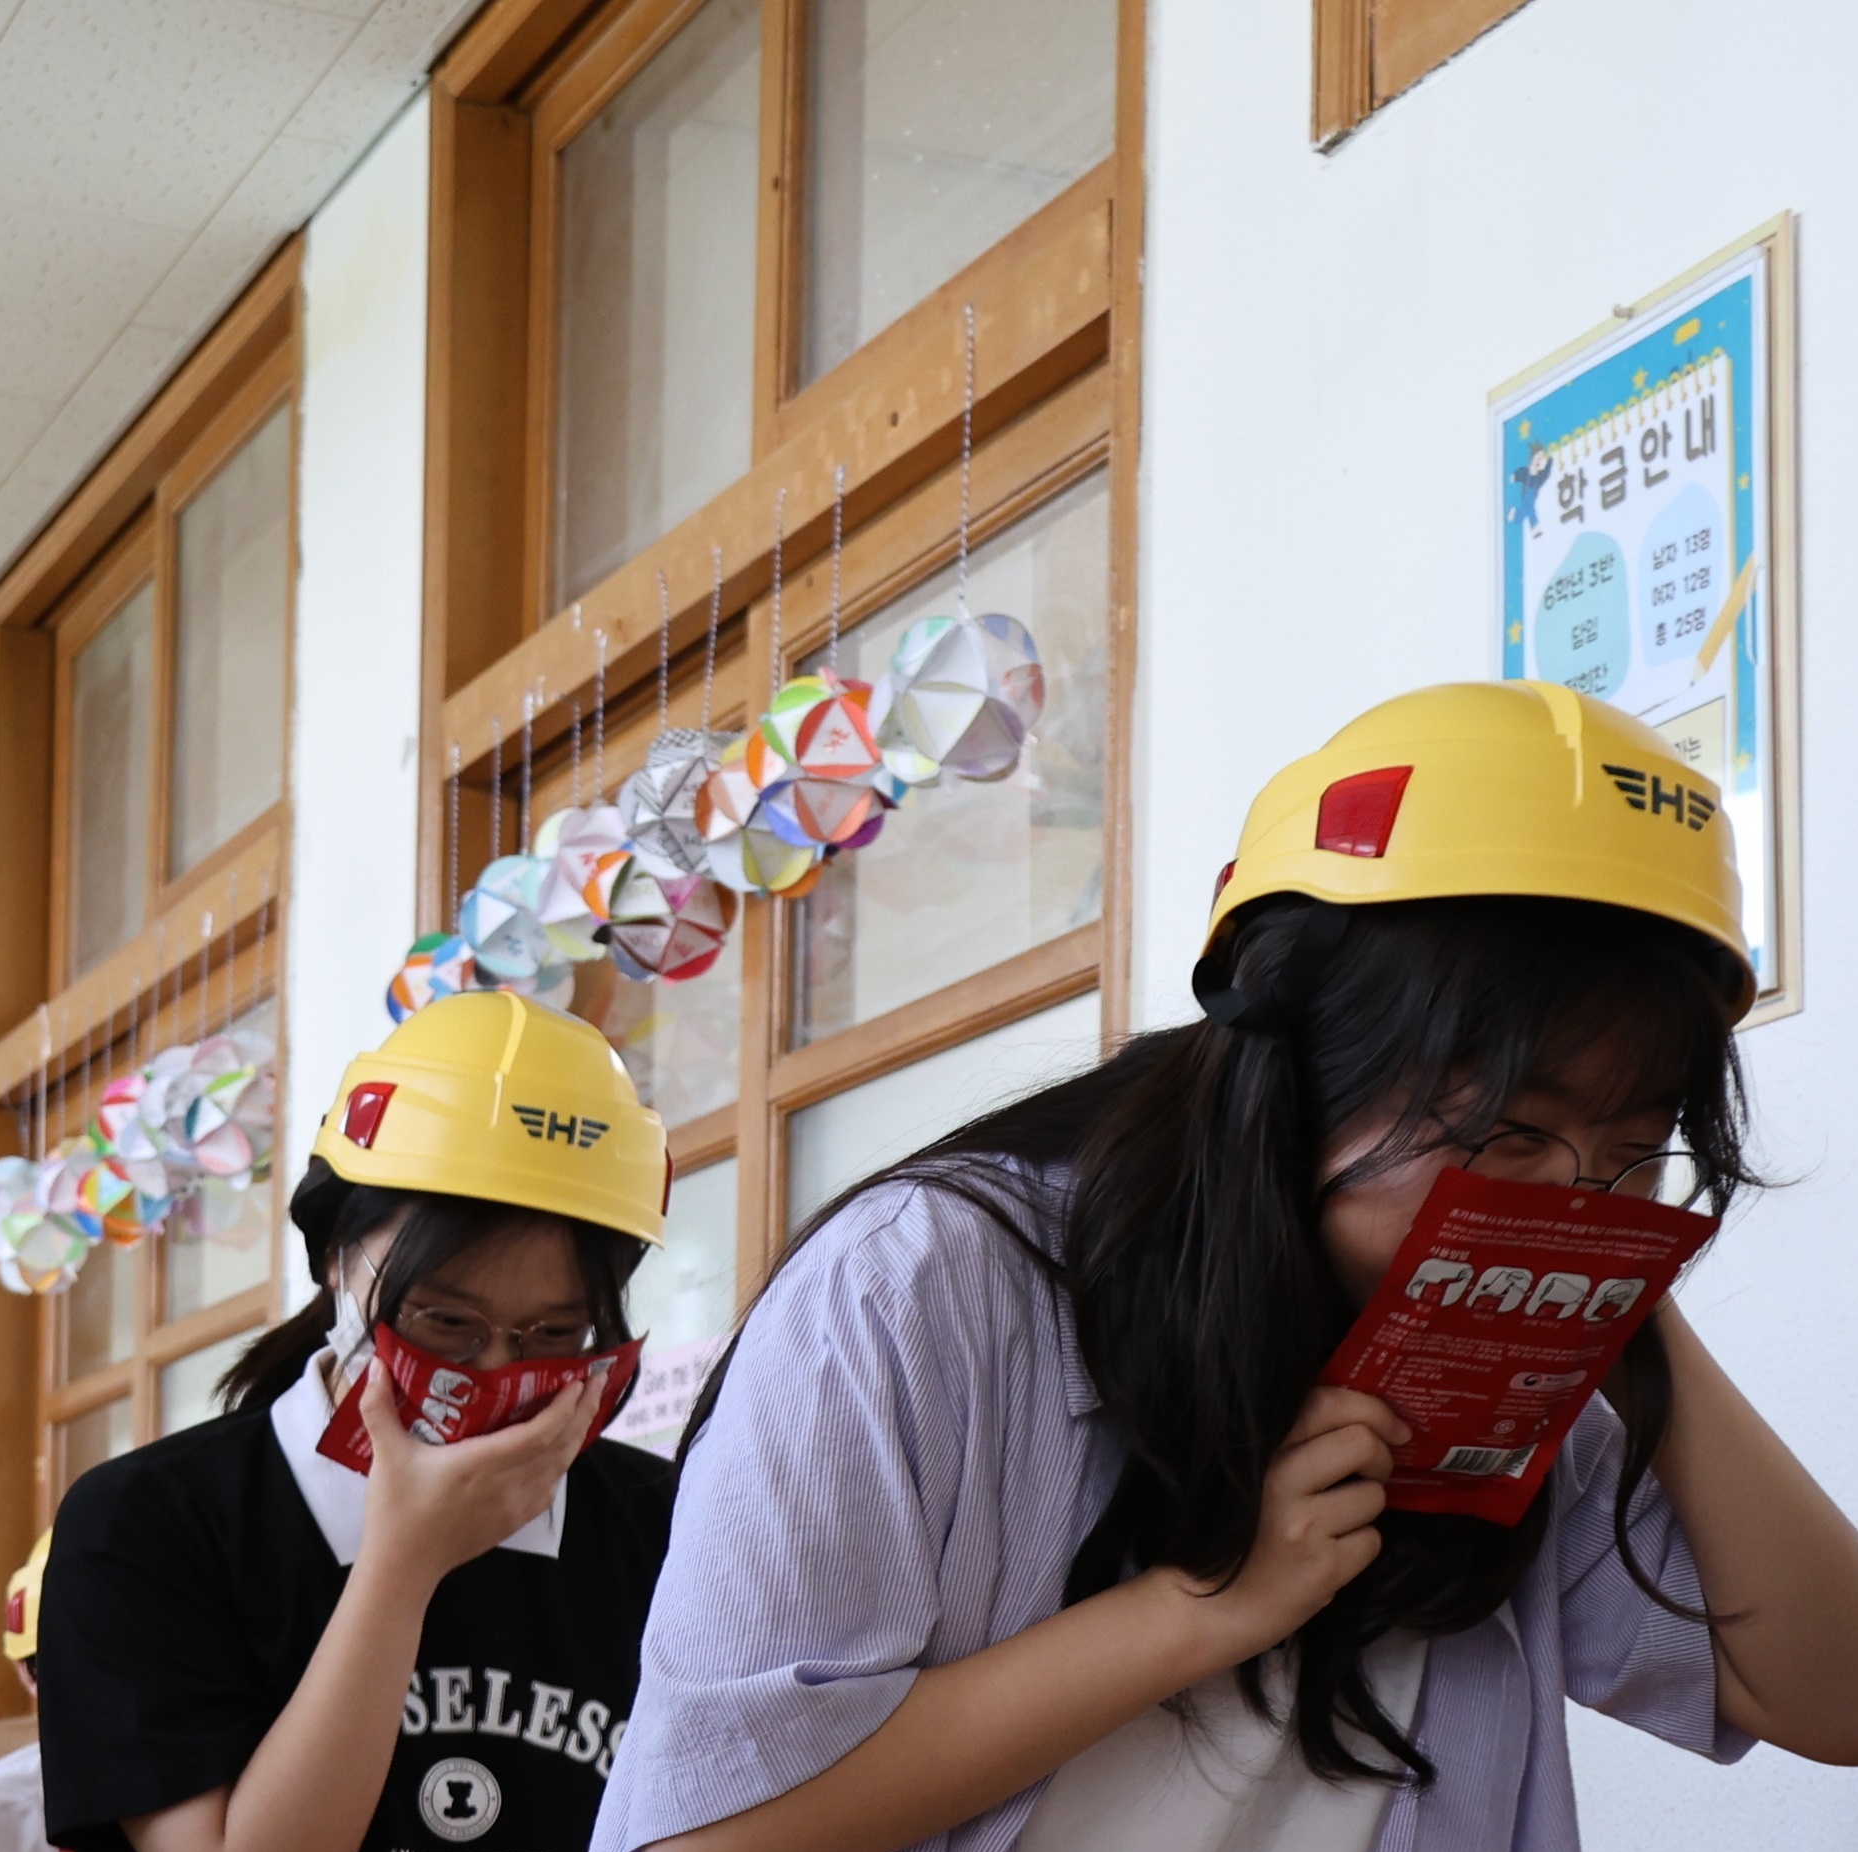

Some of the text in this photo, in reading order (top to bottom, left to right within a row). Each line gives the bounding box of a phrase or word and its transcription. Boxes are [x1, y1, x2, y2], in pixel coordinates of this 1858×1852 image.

[1557, 394, 1716, 524] 학급안내
[1652, 528, 1711, 571] 남자 13명
[1543, 553, 1616, 611] 6학년 3반
[1651, 566, 1711, 607] 여자 12명
[1572, 617, 1599, 651] 담임
[1655, 607, 1707, 647] 총 25명
